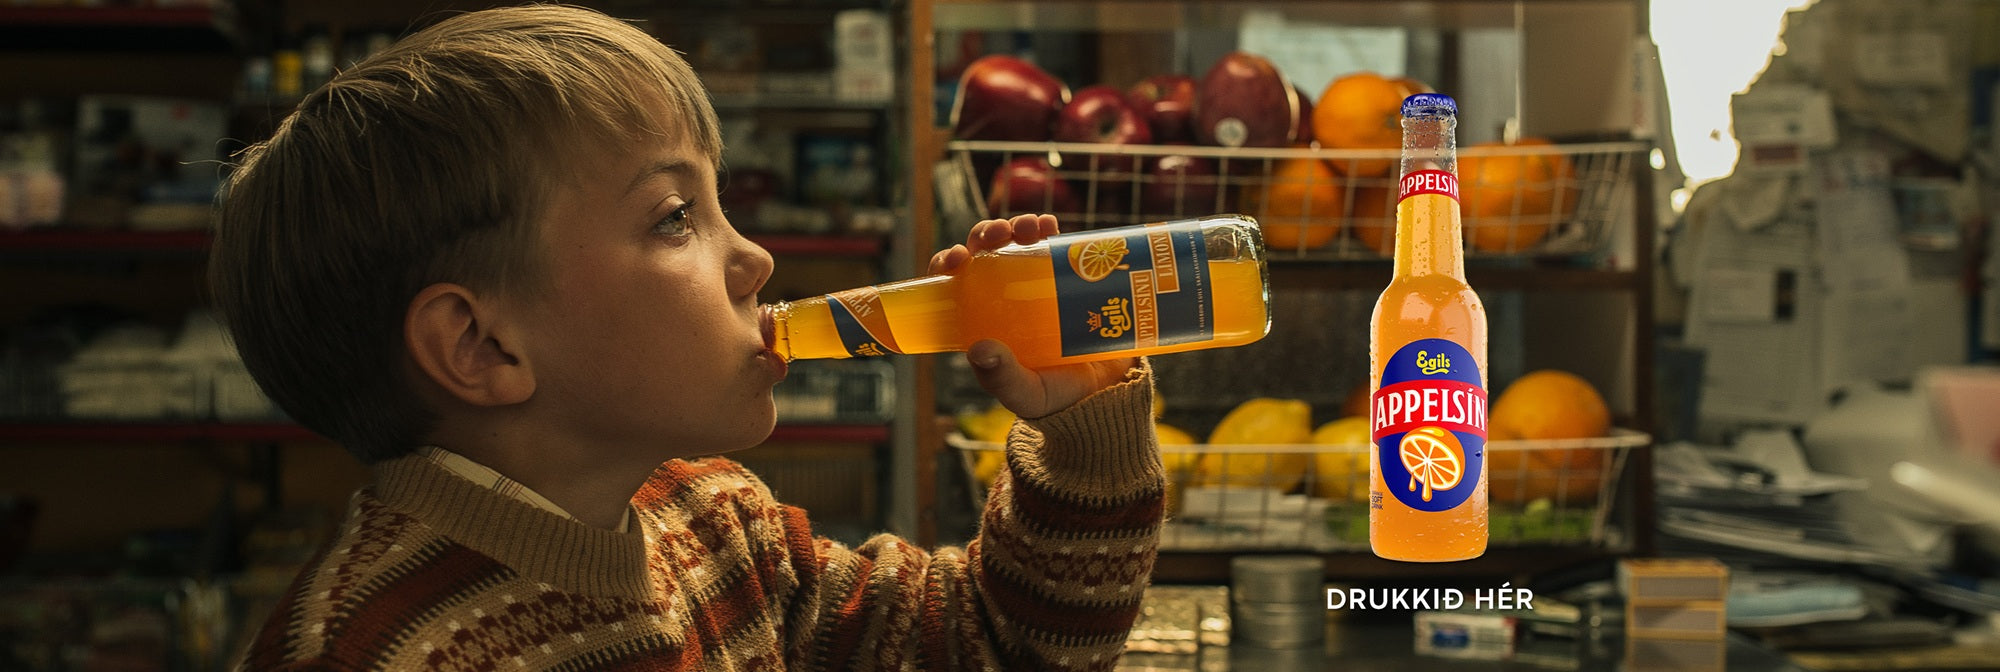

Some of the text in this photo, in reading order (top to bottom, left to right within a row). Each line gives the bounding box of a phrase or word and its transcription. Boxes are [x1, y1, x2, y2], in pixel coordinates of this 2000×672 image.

[1100, 297, 1132, 338] Egils
[1416, 350, 1451, 375] Egils
[1374, 388, 1486, 432] APPELSÍN
